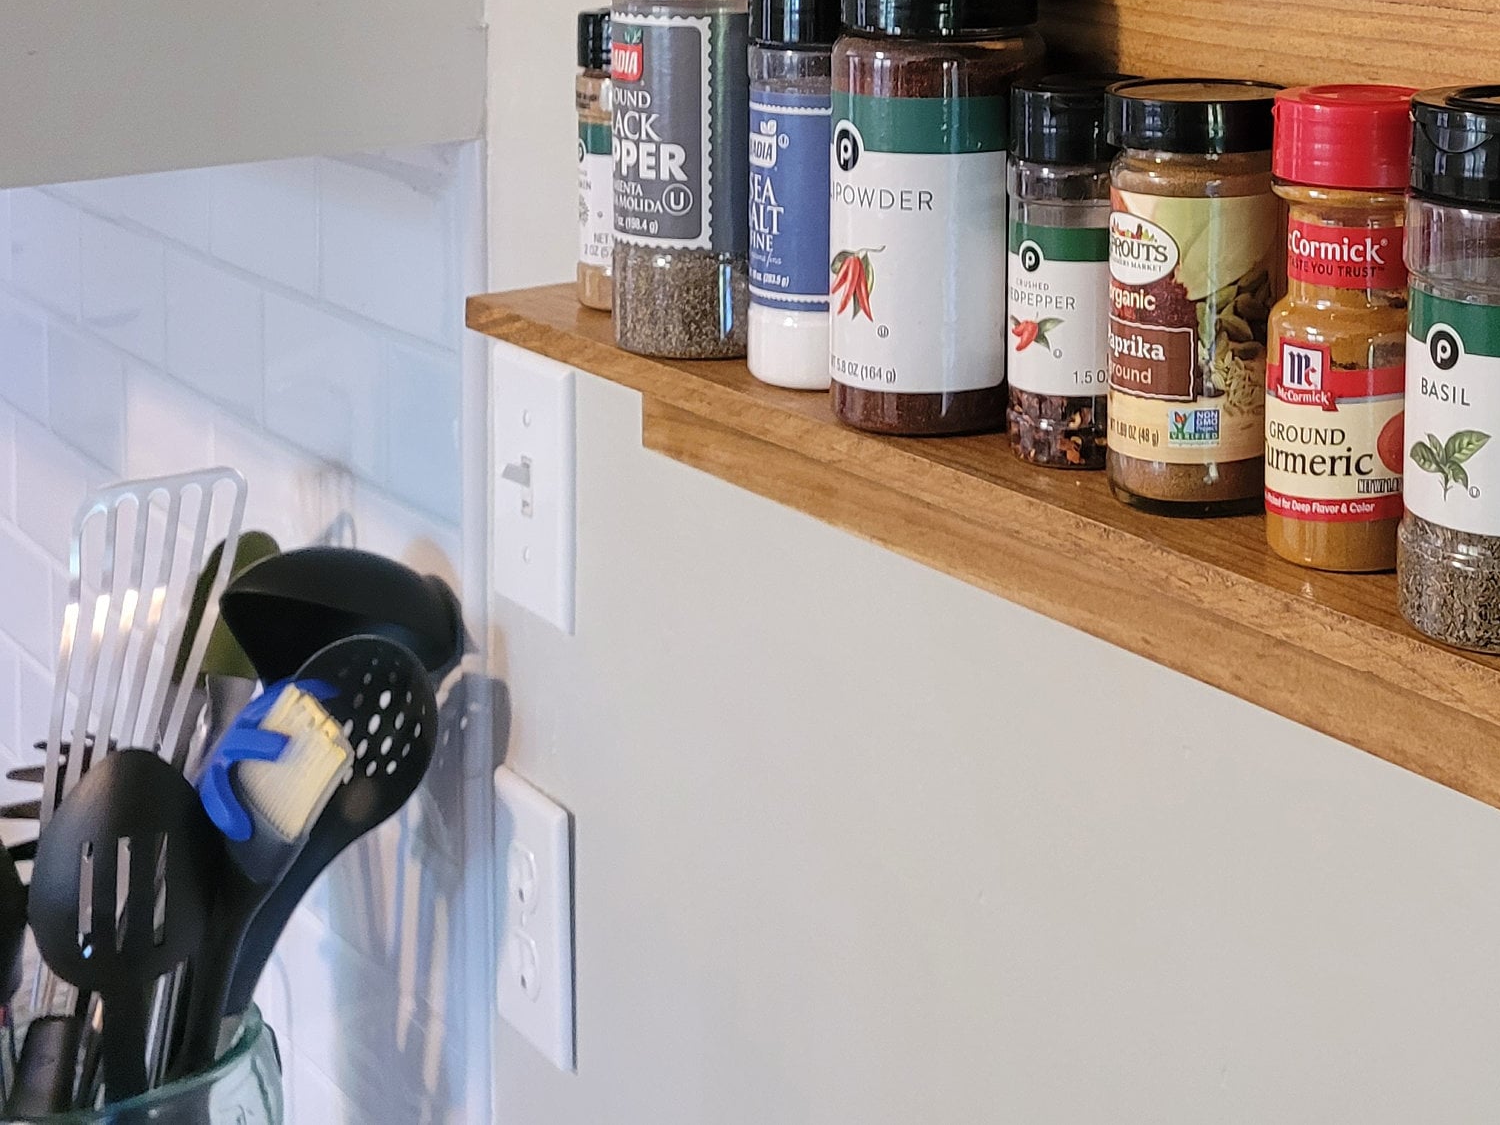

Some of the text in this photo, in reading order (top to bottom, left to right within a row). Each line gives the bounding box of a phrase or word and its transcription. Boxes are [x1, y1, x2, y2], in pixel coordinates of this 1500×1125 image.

[1311, 262, 1333, 275] YOU
[1338, 265, 1376, 278] TRUST
[1016, 278, 1050, 291] CRUSHED
[837, 358, 846, 373] 5.8
[849, 361, 859, 377] OZ
[861, 362, 882, 381] (164
[885, 366, 897, 384] g)
[1073, 370, 1092, 384] 1.5
[1277, 384, 1329, 405] McCormick
[1421, 377, 1471, 407] BASIL
[1197, 411, 1218, 419] NON
[1197, 418, 1218, 426] GMO
[1128, 425, 1136, 440] OZ
[1269, 421, 1346, 445] GROUND
[1358, 478, 1385, 493] NET WT
[1292, 500, 1311, 514] Deep
[1312, 502, 1339, 514] Flavor
[1341, 502, 1347, 513] &
[1349, 502, 1375, 513] Color
